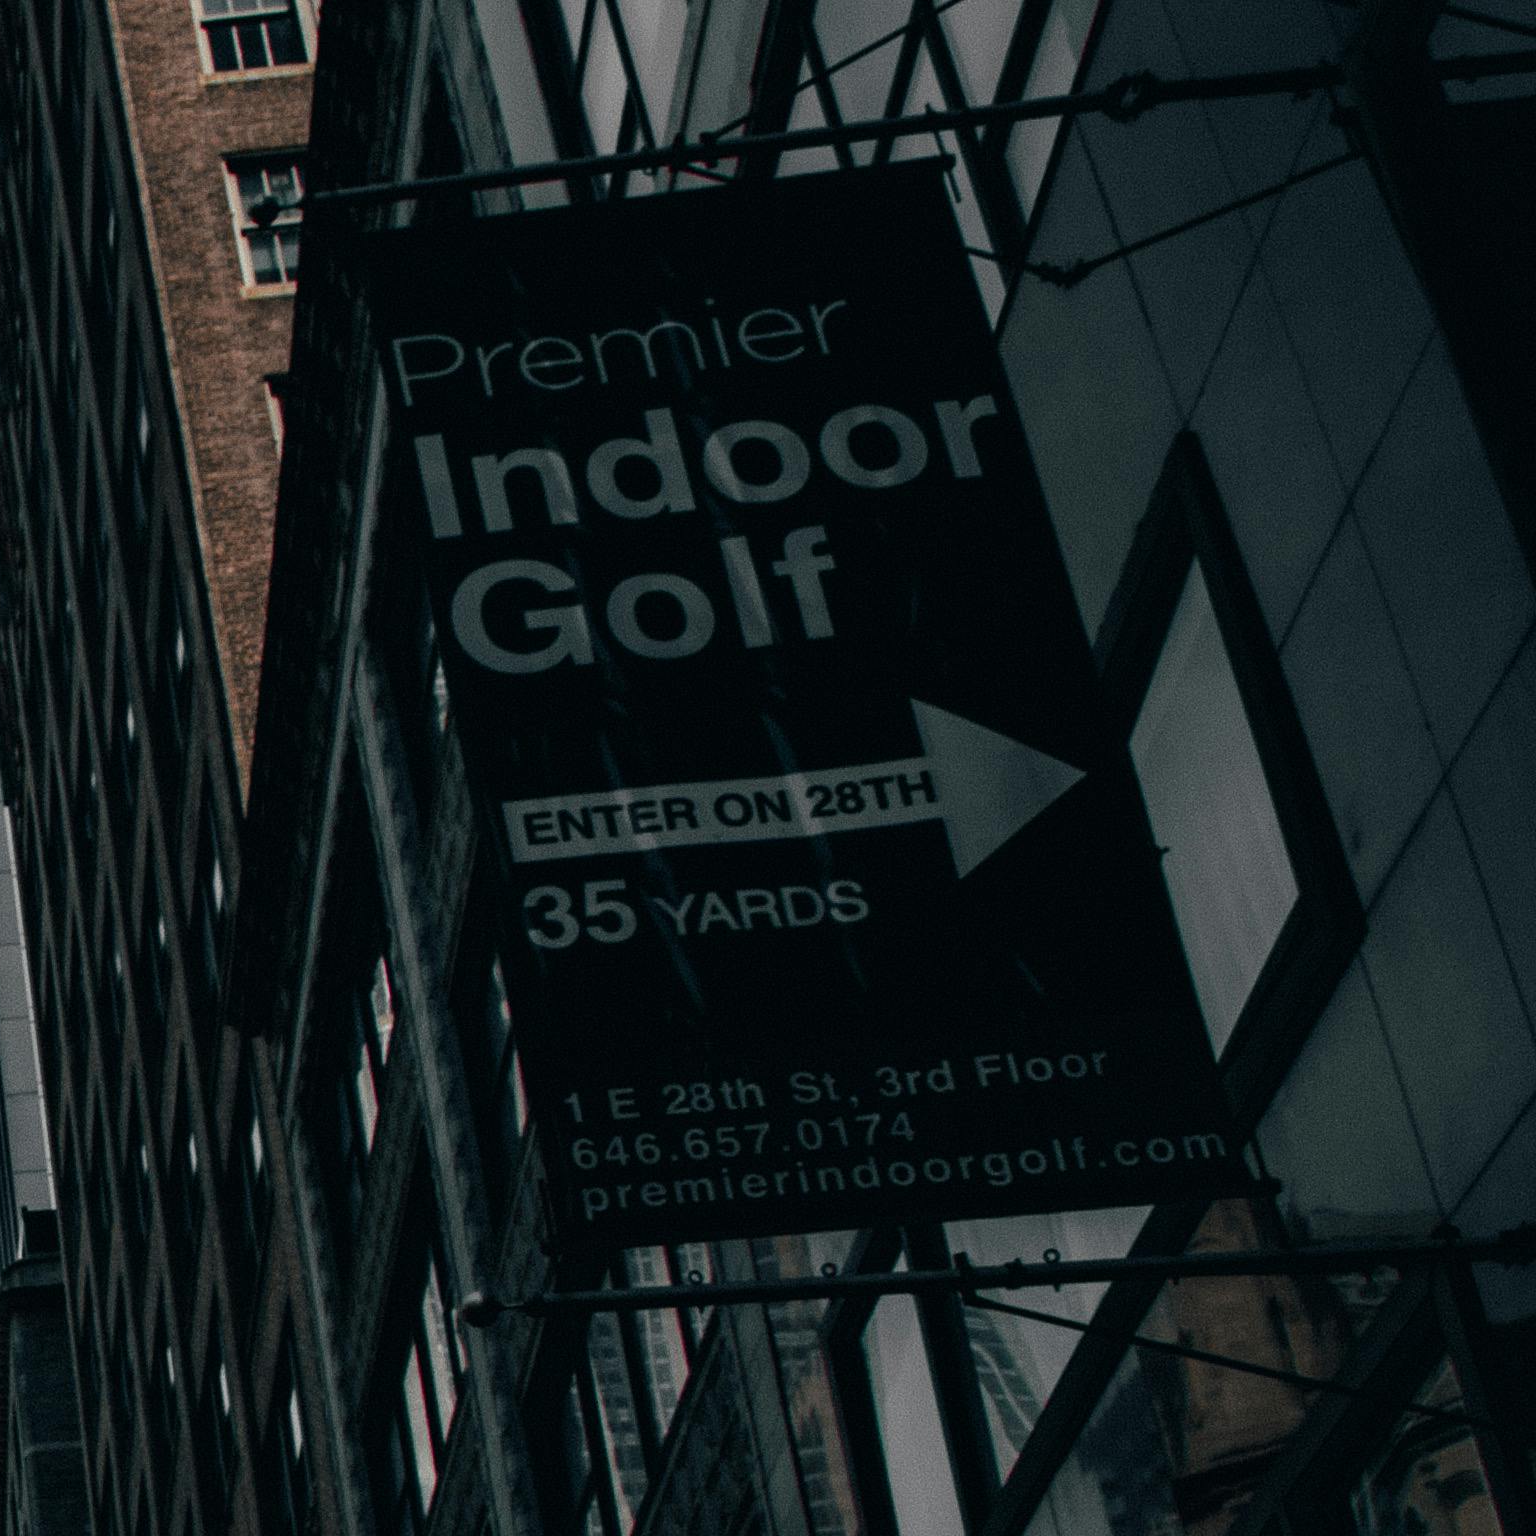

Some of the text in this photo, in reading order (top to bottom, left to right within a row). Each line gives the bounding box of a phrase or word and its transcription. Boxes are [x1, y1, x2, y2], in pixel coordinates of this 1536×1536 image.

[391, 295, 848, 408] Premier
[414, 393, 1000, 538] Indoor
[450, 525, 838, 674] Golf
[523, 771, 935, 847] ENTER ON 28TH
[525, 879, 868, 950] 35 YARDS
[564, 1045, 1111, 1123] 1 E 28th St, 3rd Floor
[571, 1112, 916, 1171] 646.657.0174
[582, 1125, 1226, 1218] premierindoorgolf.com
